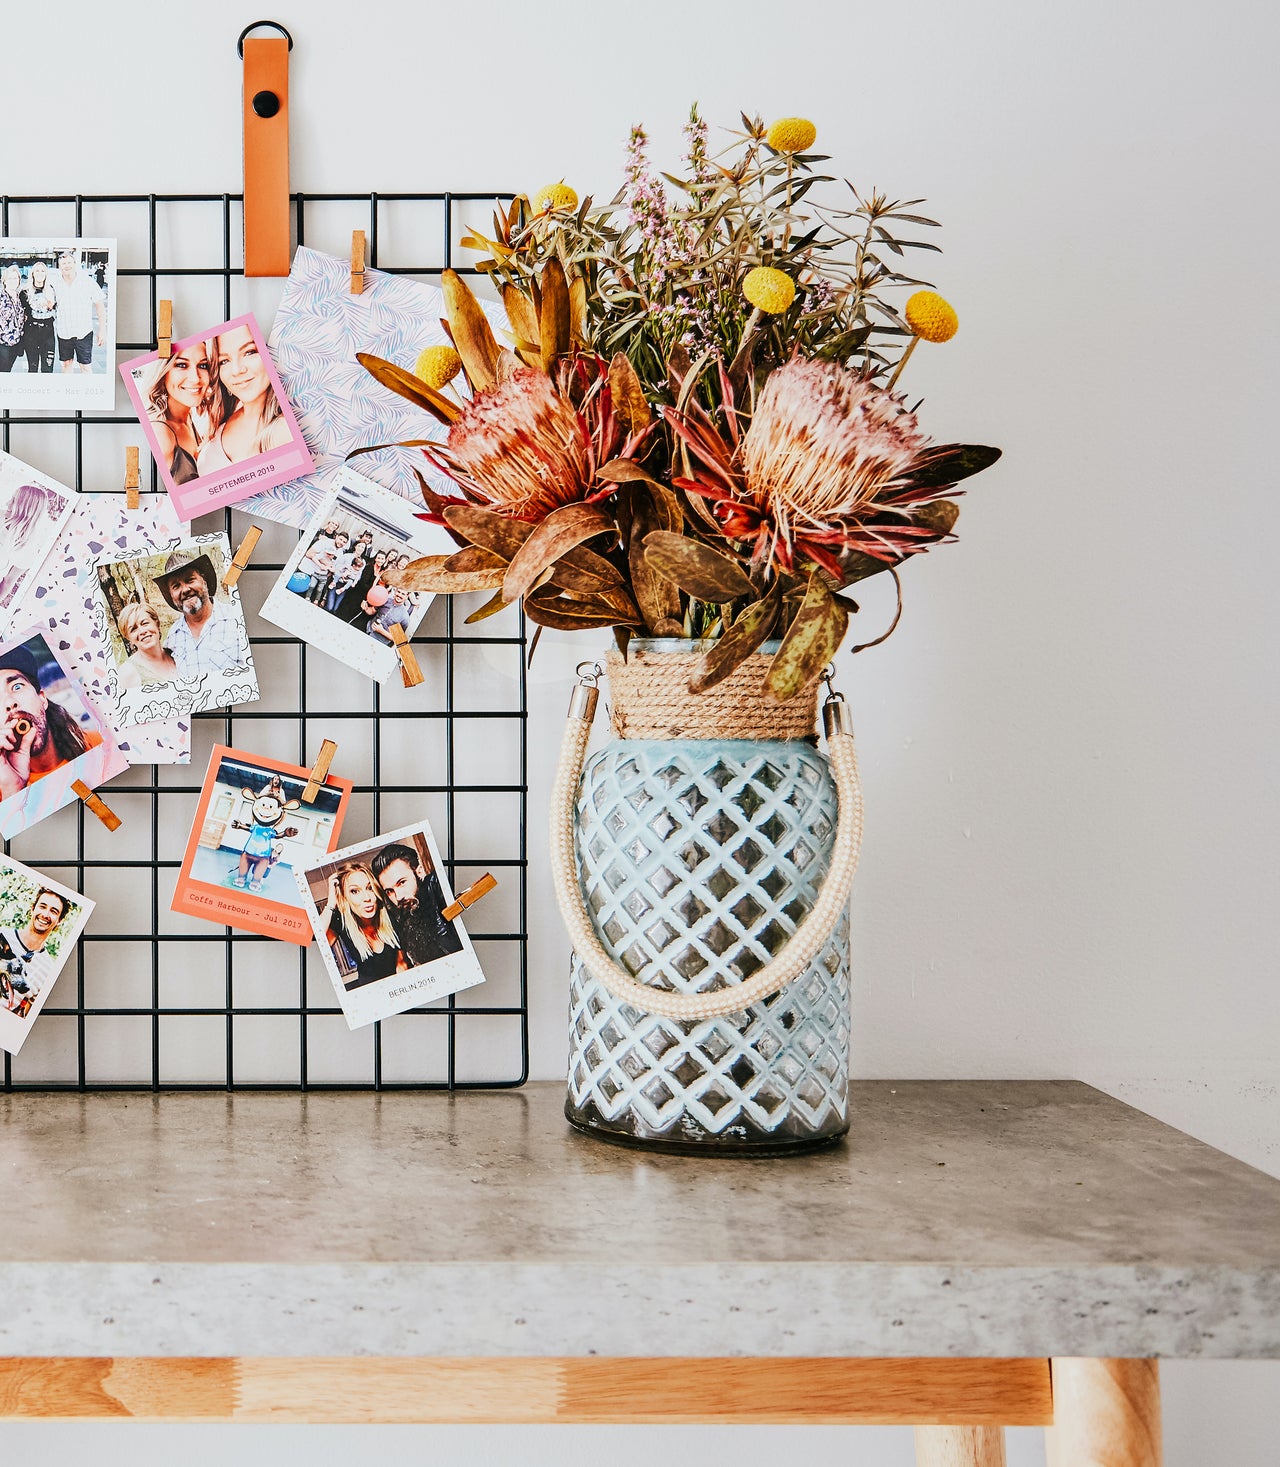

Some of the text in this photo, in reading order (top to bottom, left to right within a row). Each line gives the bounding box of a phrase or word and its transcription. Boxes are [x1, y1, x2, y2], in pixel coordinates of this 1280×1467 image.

[208, 464, 275, 496] SEPTEMBER 2019
[189, 893, 213, 905] Coffs
[217, 901, 251, 916] Harbour
[264, 914, 278, 923] Jul
[282, 918, 302, 929] 2017
[388, 976, 436, 998] BERLIN 2016
